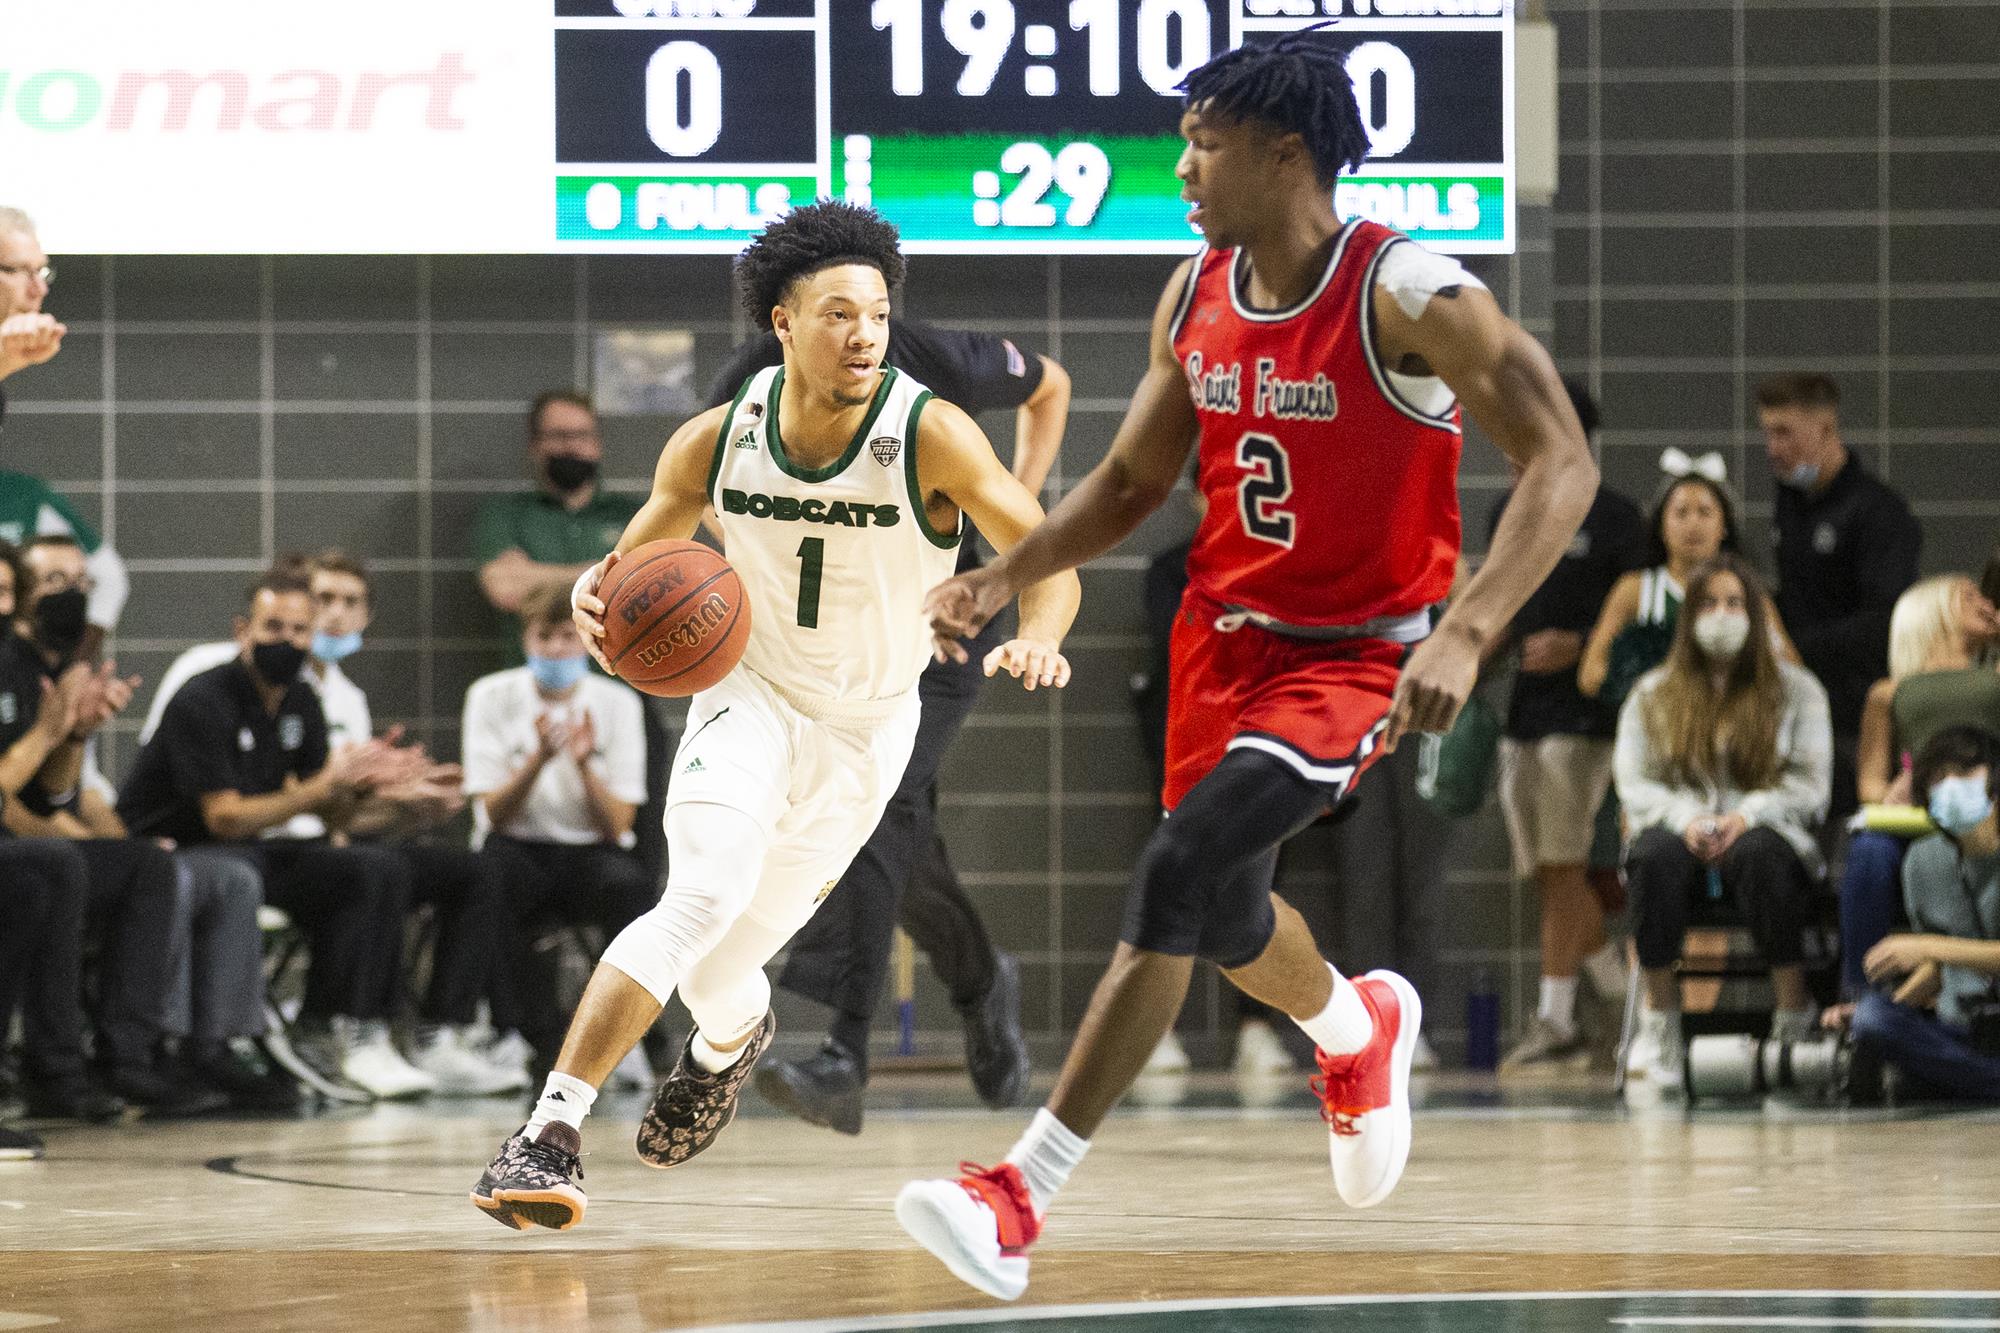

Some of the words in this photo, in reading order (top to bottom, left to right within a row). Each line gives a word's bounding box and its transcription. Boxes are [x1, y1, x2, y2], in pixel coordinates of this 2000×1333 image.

[871, 0, 1211, 96] 19:10
[0, 51, 477, 132] omart
[646, 41, 721, 157] 0
[1343, 41, 1416, 157] 0
[636, 182, 791, 230] FOULS
[972, 142, 1111, 227] :29
[1335, 182, 1480, 230] FOULS
[1186, 350, 1242, 415] Saint
[1254, 356, 1338, 422] Francis
[872, 445, 900, 455] MAC
[1235, 431, 1296, 550] 2
[722, 488, 901, 528] BOBCATS
[796, 536, 825, 629] 1
[636, 592, 732, 668] Wilson
